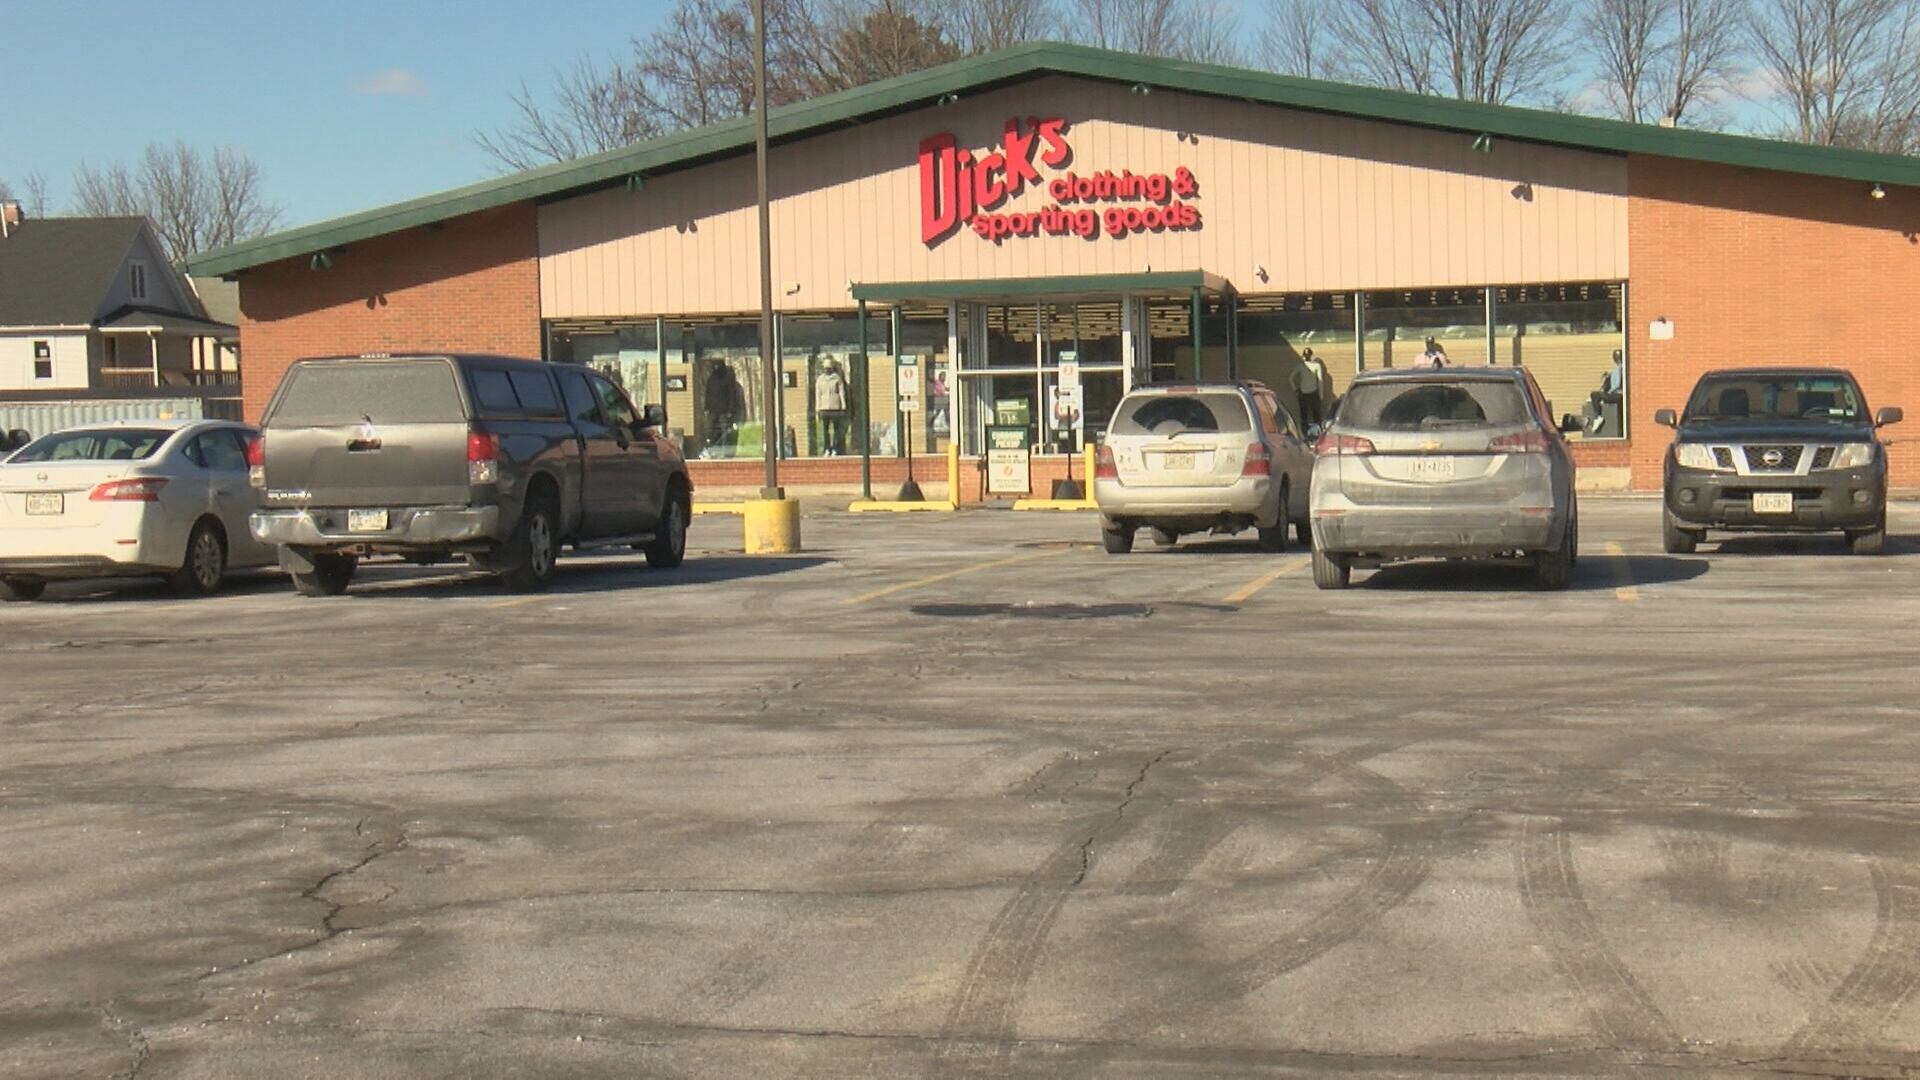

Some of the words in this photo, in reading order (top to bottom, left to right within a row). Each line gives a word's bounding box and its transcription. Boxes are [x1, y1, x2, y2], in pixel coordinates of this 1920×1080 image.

[1049, 170, 1166, 200] clothing
[1172, 166, 1195, 196] &
[972, 204, 1094, 240] sporting
[1103, 200, 1199, 236] goods
